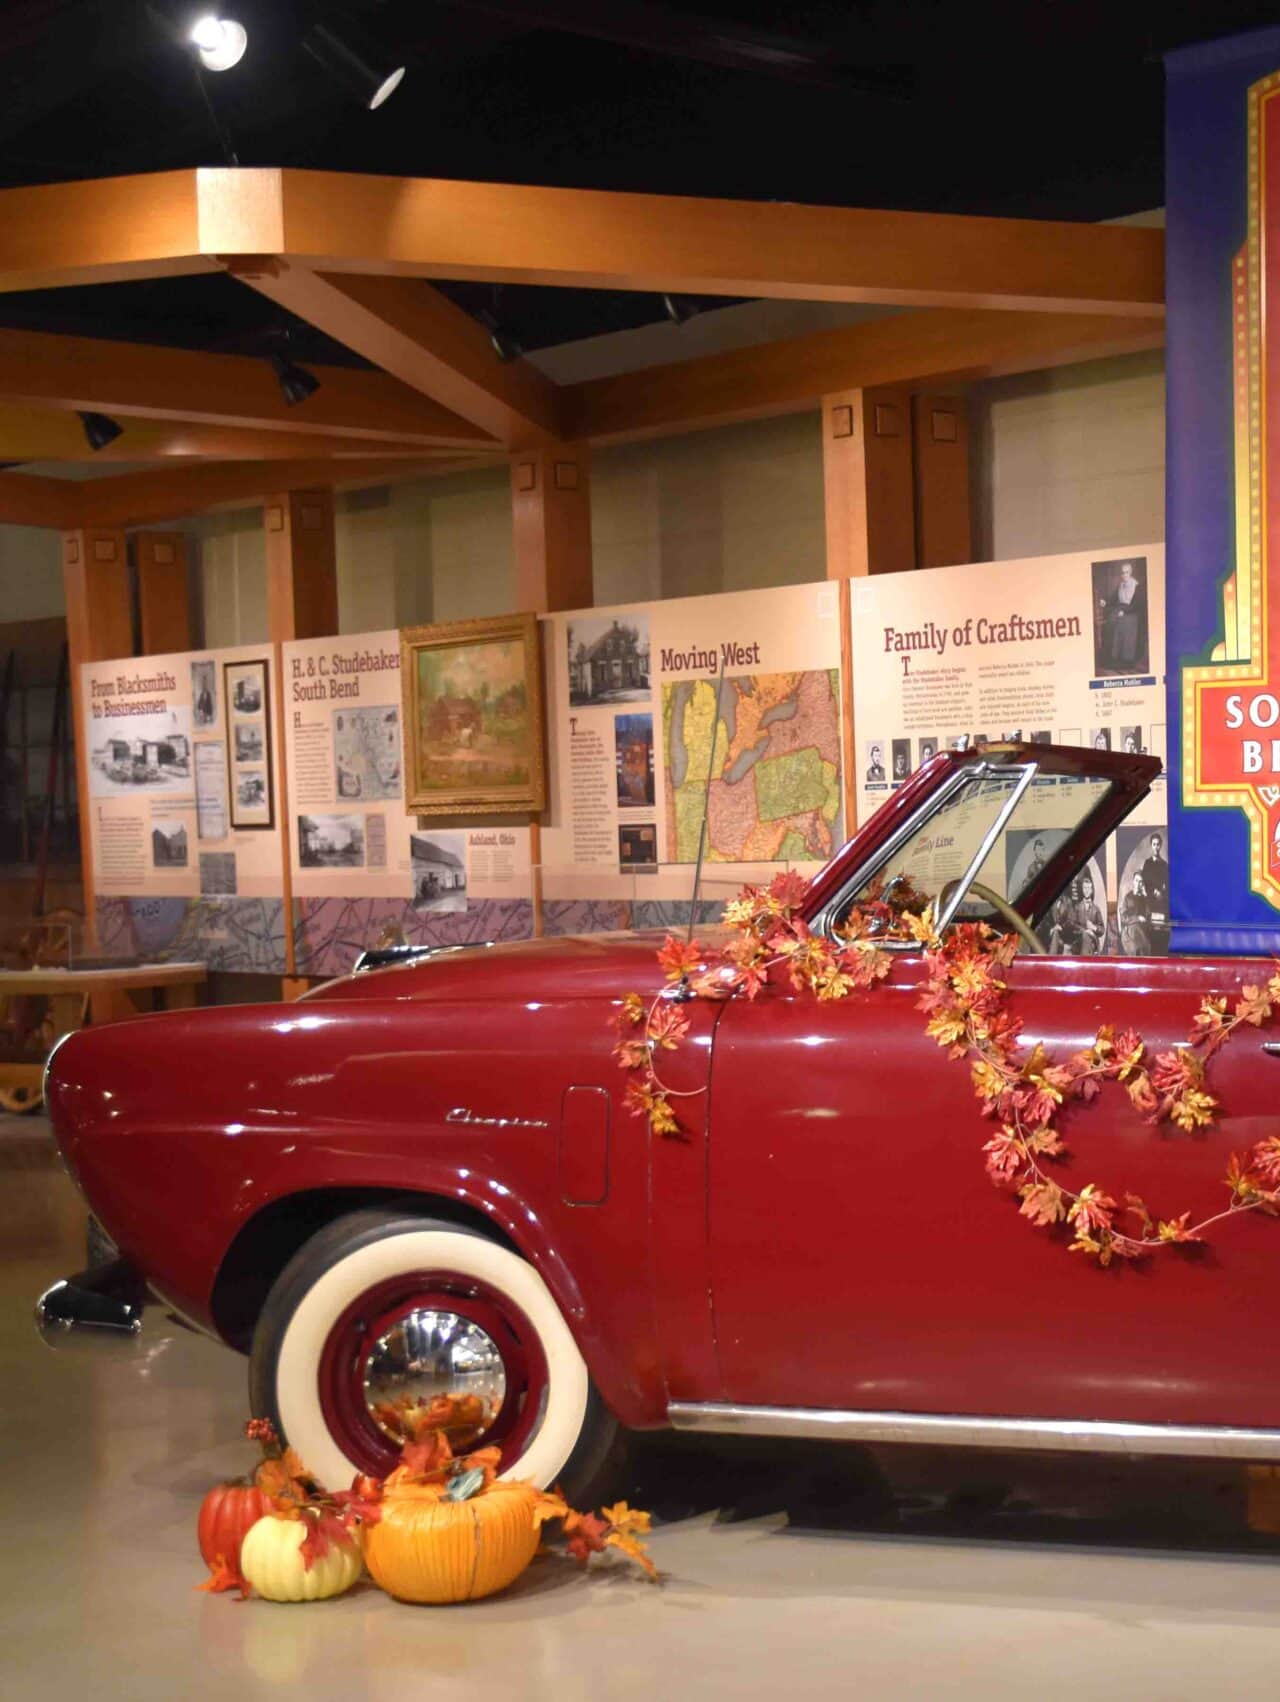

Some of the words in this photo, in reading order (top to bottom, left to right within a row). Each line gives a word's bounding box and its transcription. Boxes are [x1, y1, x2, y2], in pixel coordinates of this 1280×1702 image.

[884, 622, 947, 654] Family
[952, 618, 973, 647] of
[976, 614, 1081, 644] Craftsmen
[292, 659, 305, 678] H.
[307, 657, 315, 677] &
[318, 656, 330, 675] C.
[332, 649, 400, 675] Studebaker
[661, 645, 717, 674] Moving
[721, 641, 760, 666] West
[91, 679, 115, 697] From
[117, 672, 176, 696] Blacksmiths
[293, 680, 327, 701] South
[330, 676, 360, 699] Bend
[92, 702, 103, 718] to
[104, 699, 167, 717] Businessmen
